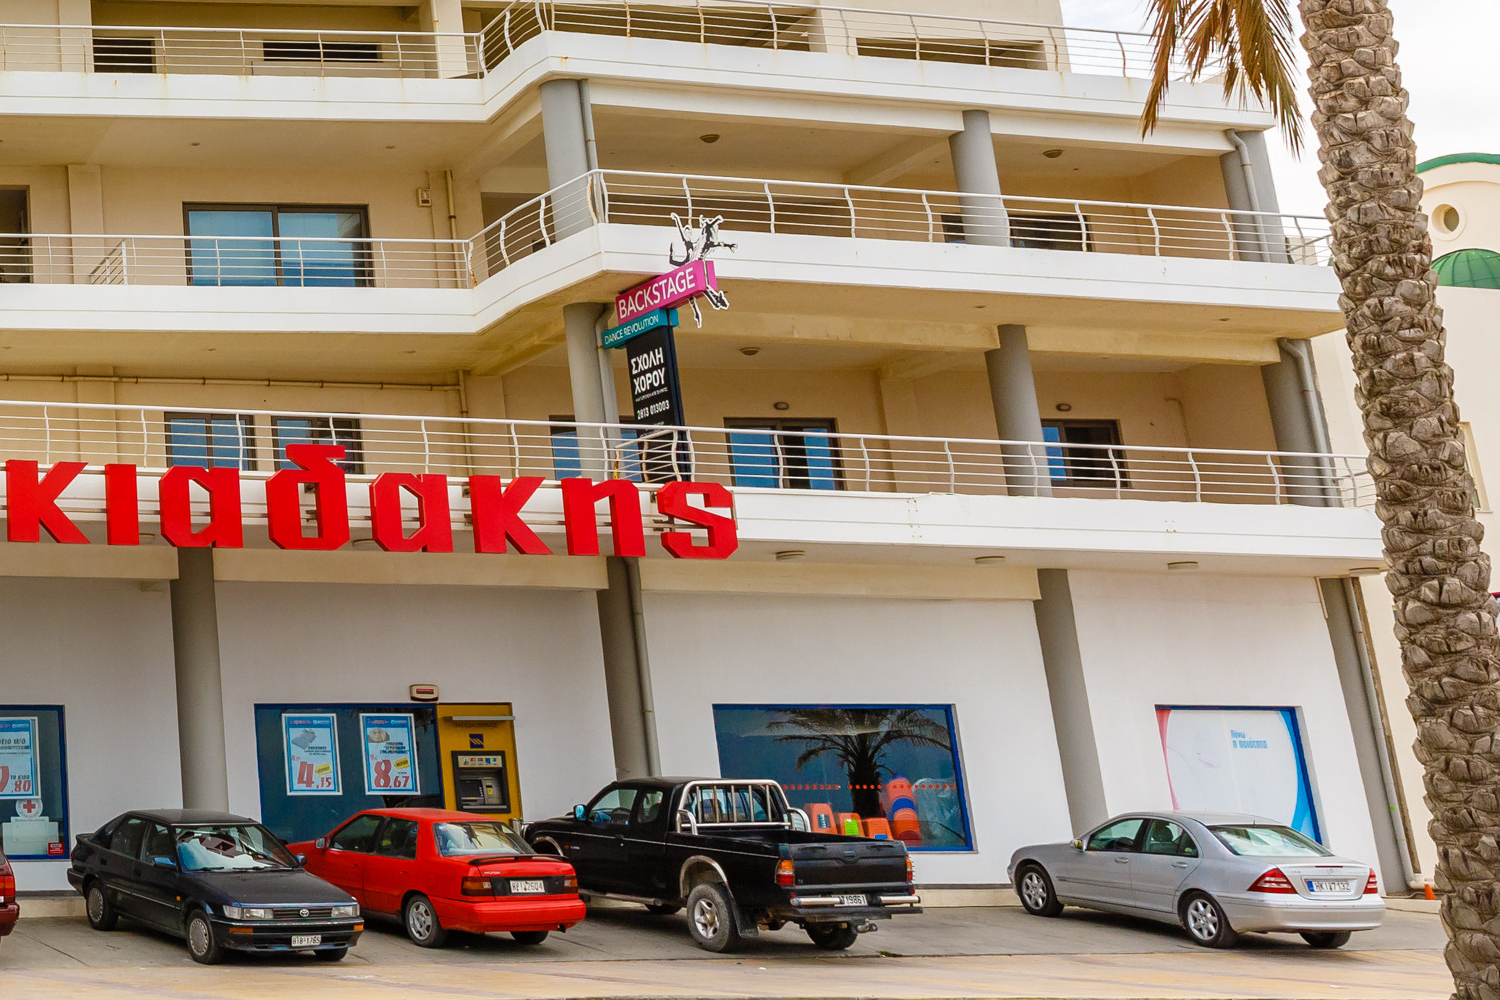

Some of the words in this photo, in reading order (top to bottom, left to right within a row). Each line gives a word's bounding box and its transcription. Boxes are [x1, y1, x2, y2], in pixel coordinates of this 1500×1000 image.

[618, 267, 696, 319] BACKSTAGE
[604, 329, 623, 345] DANCE
[623, 315, 659, 336] REVOLUTION
[631, 347, 664, 375] ΣΧΟΛΗ
[633, 367, 666, 395] ΧΟΡΟΥ
